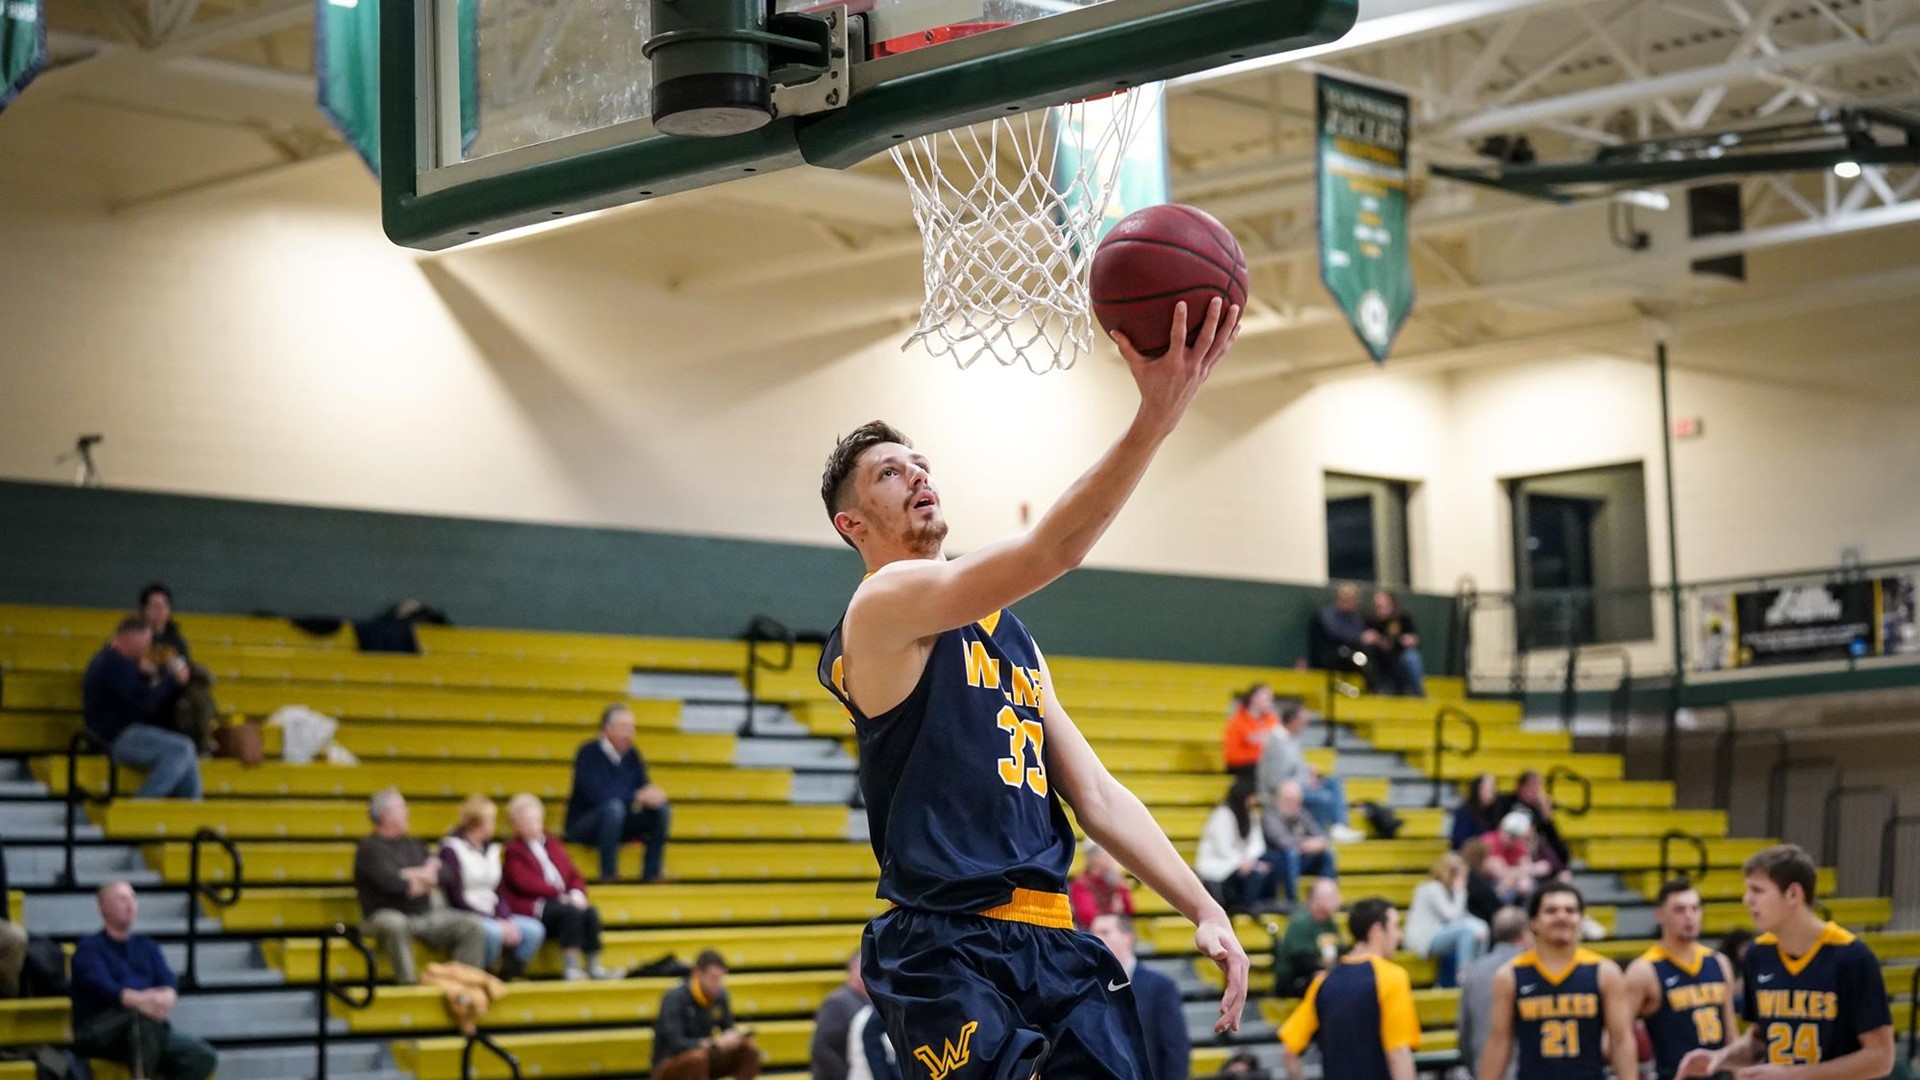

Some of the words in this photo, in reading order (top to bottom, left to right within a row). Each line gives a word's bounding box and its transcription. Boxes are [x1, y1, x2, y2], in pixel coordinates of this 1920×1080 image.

[997, 704, 1048, 799] 33
[1518, 993, 1598, 1020] WILKES
[1755, 989, 1838, 1020] WILKES
[1541, 1019, 1580, 1058] 21
[1692, 1006, 1723, 1045] 15
[1767, 1022, 1822, 1066] 24
[912, 1020, 979, 1080] W
